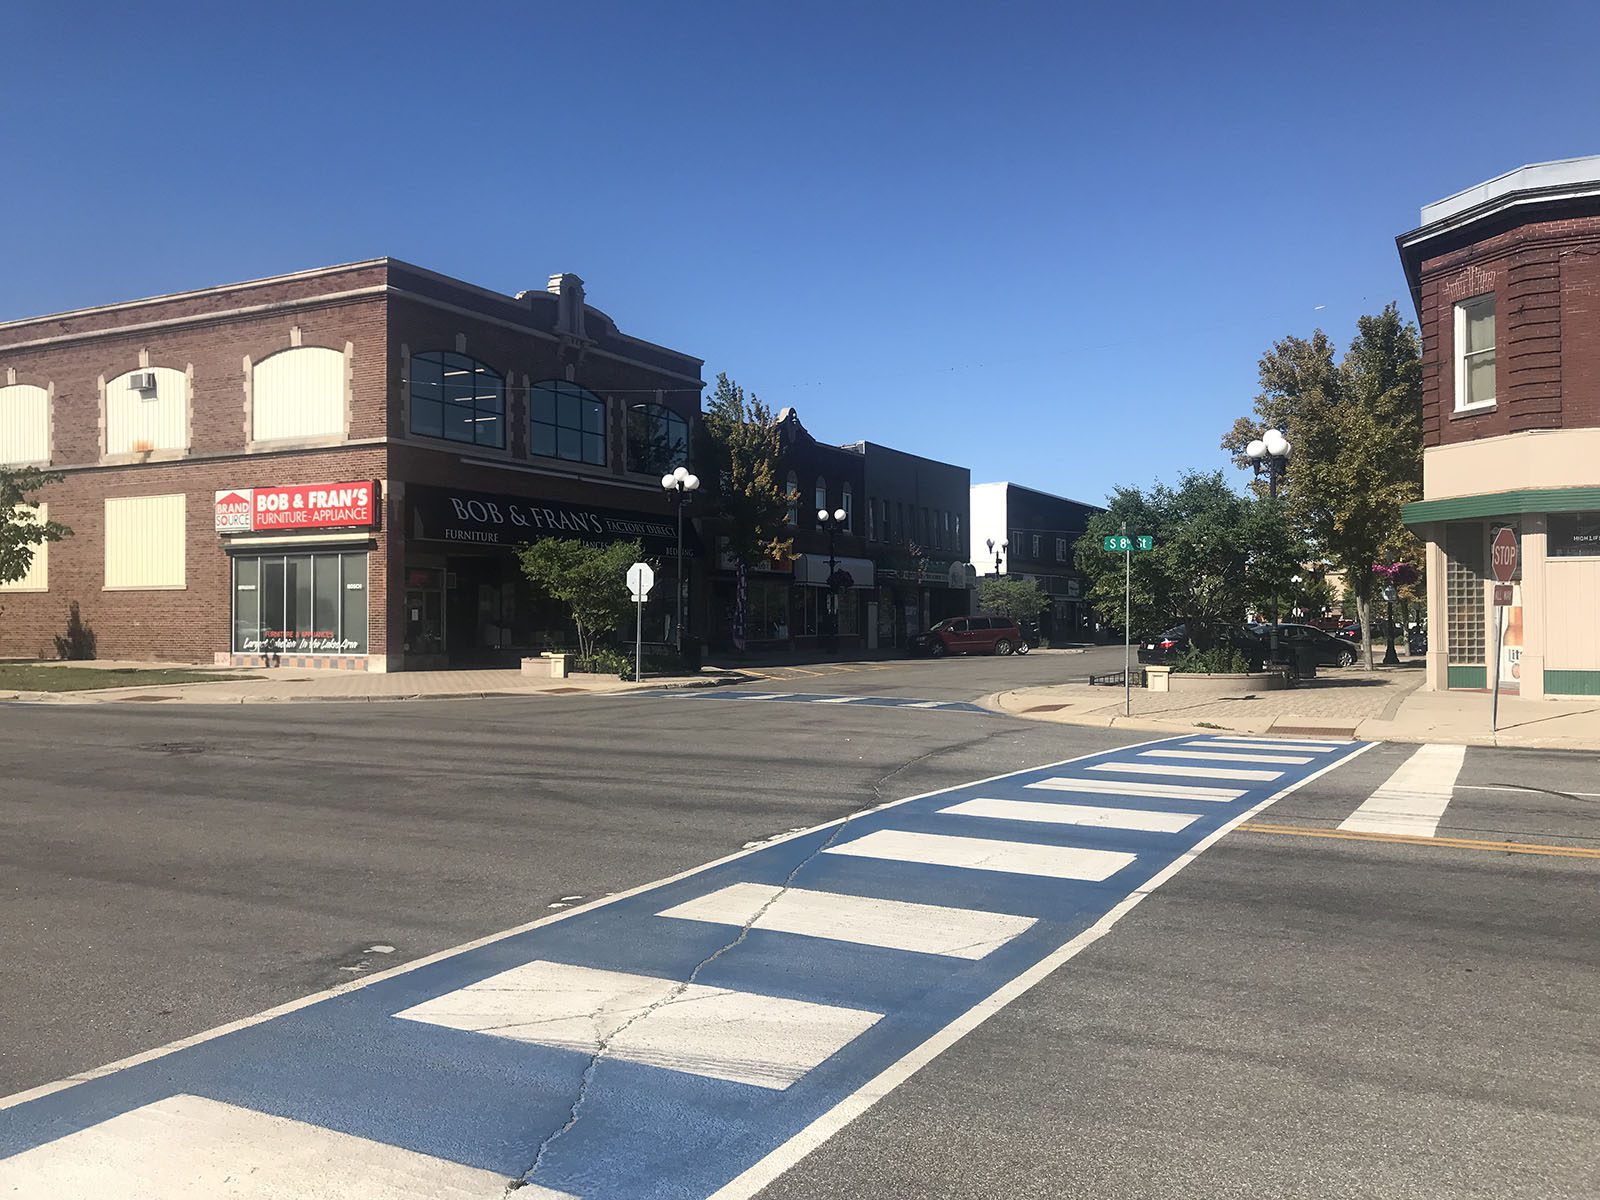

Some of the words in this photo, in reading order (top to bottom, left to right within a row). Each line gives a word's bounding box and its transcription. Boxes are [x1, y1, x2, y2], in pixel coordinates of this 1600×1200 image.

[257, 493, 289, 511] BOB
[293, 494, 304, 508] &
[308, 488, 368, 508] FRAN'S
[216, 502, 249, 514] BRAND
[449, 497, 504, 524] BOB
[509, 504, 532, 526] &
[529, 507, 603, 533] FRAN'S
[216, 513, 249, 526] SOURCE
[257, 508, 367, 525] FURNITURE-APPLIANCE
[445, 528, 499, 542] FURNITURE
[606, 521, 646, 534] FACTORY
[646, 524, 677, 537] DIRECT
[1109, 538, 1117, 549] S
[1136, 538, 1146, 549] St
[1494, 545, 1516, 565] STOP
[1503, 590, 1512, 600] WAY
[1508, 649, 1522, 663] Lit
